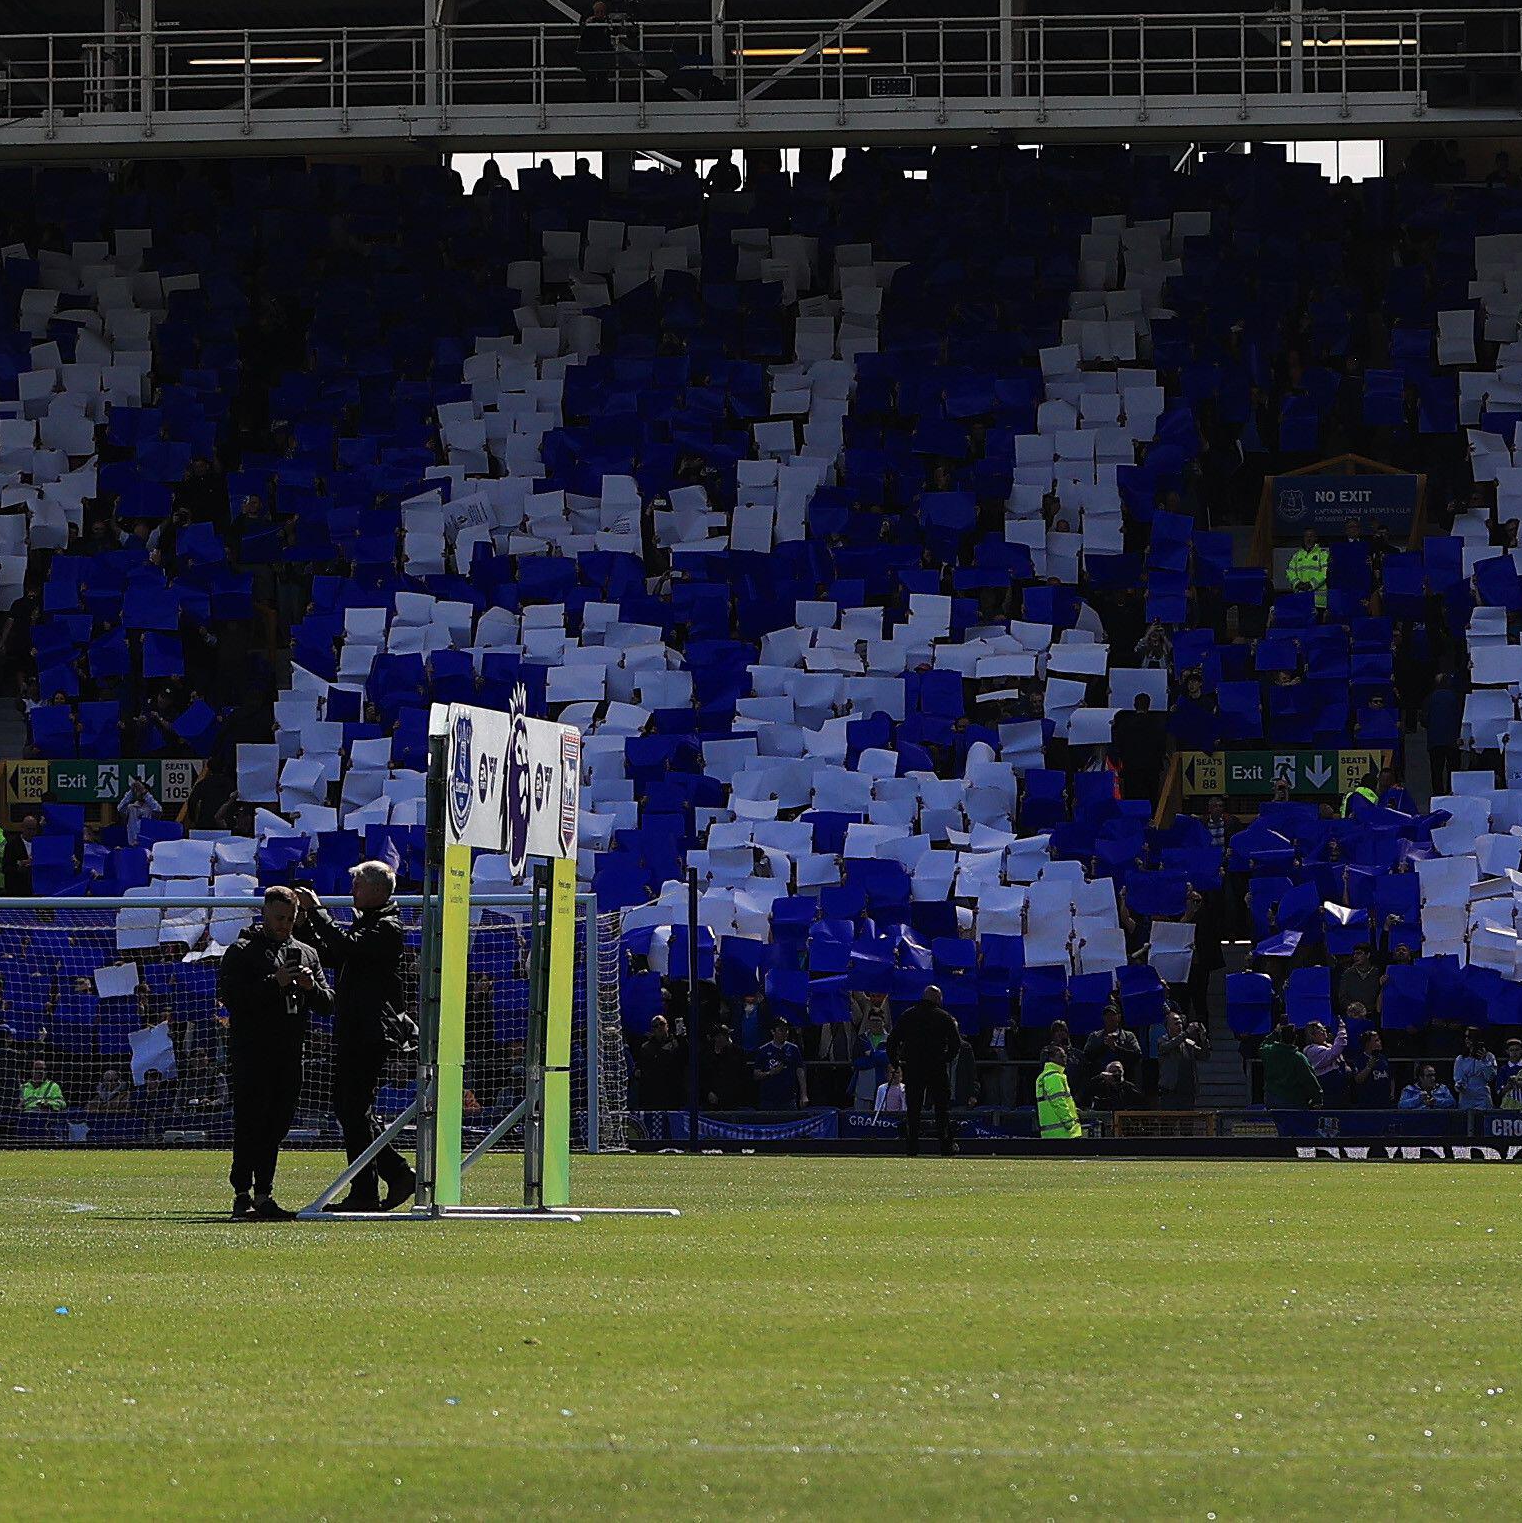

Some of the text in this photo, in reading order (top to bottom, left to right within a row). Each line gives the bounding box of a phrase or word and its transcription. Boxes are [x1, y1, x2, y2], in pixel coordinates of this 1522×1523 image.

[1314, 490, 1372, 503] NO EXIT
[1232, 765, 1263, 779] Exit
[1347, 766, 1360, 776] 61
[57, 774, 87, 788] Exit
[168, 772, 185, 784] 89
[165, 787, 189, 799] 105
